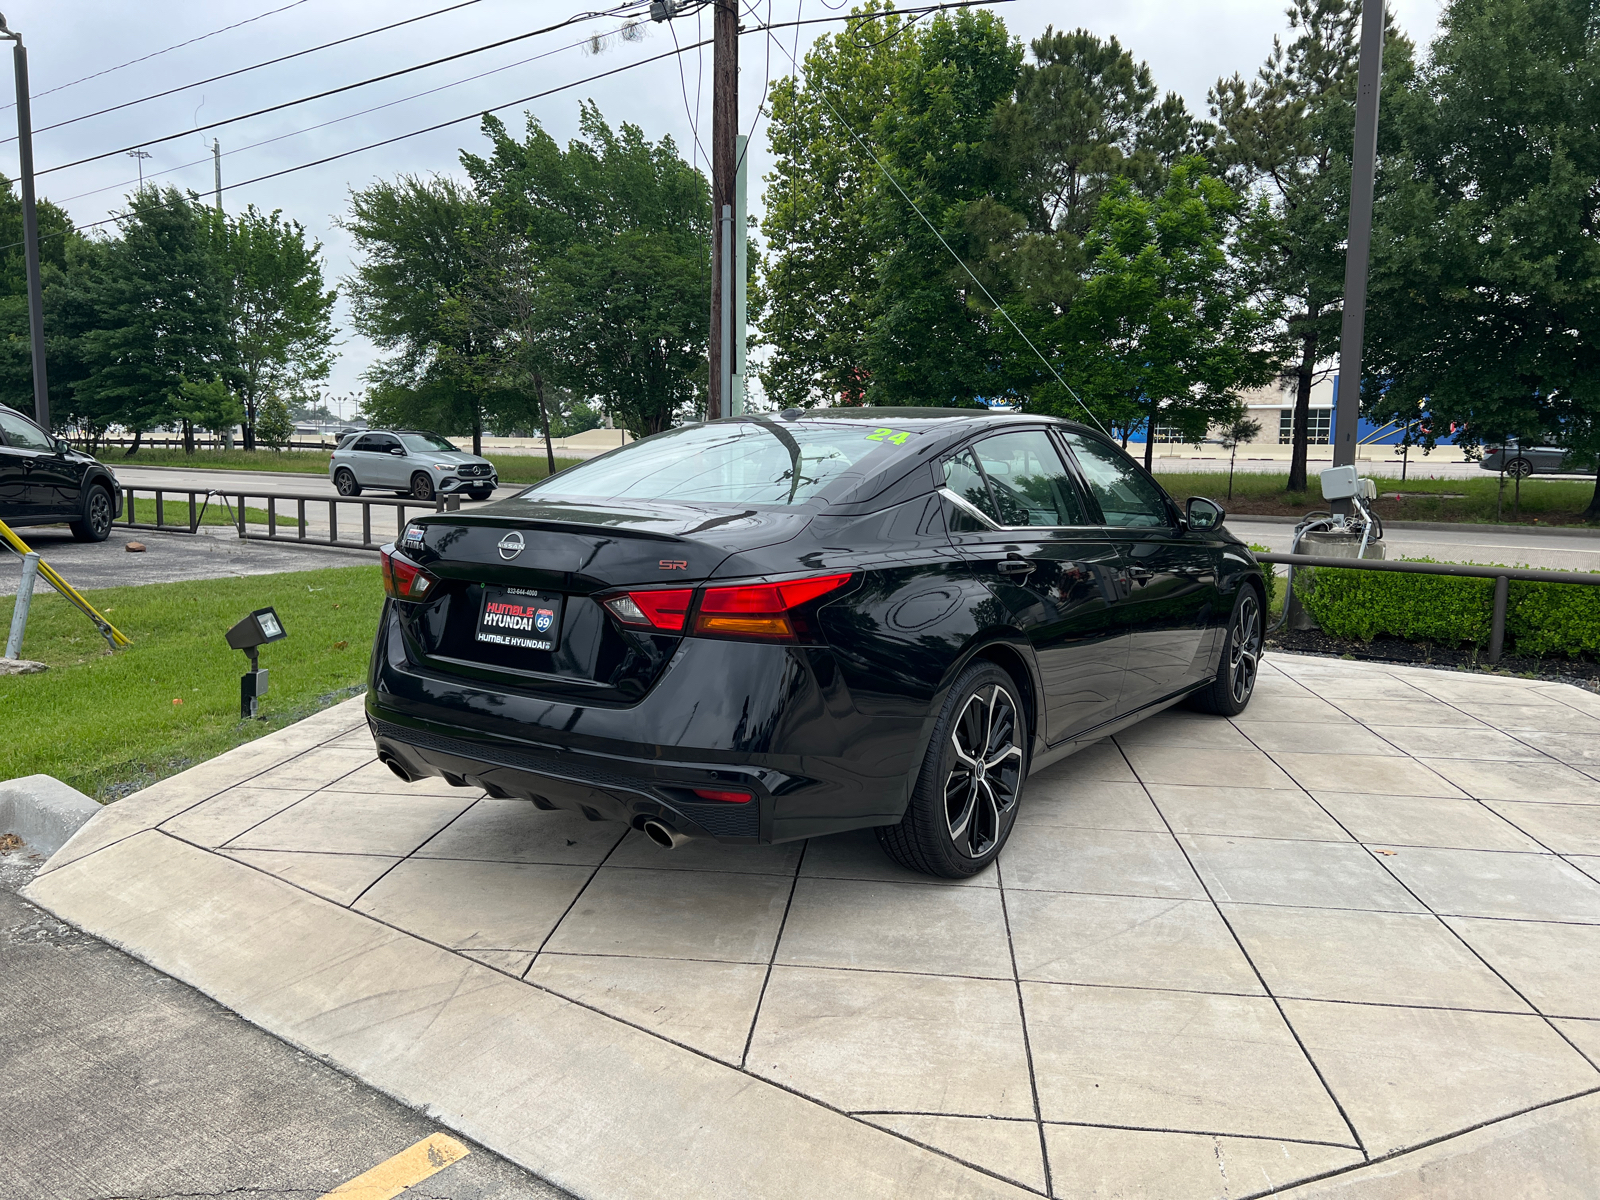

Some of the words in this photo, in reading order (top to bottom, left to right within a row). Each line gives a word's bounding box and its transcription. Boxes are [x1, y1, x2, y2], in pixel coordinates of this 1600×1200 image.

[866, 428, 911, 446] 24
[498, 542, 525, 550] NISSAN
[659, 560, 688, 570] SR
[487, 602, 535, 618] HUMBLE
[484, 613, 533, 631] HYUNDAI
[537, 617, 550, 629] 69
[478, 633, 511, 645] HUMBLE
[511, 638, 546, 650] HYUNDAI
